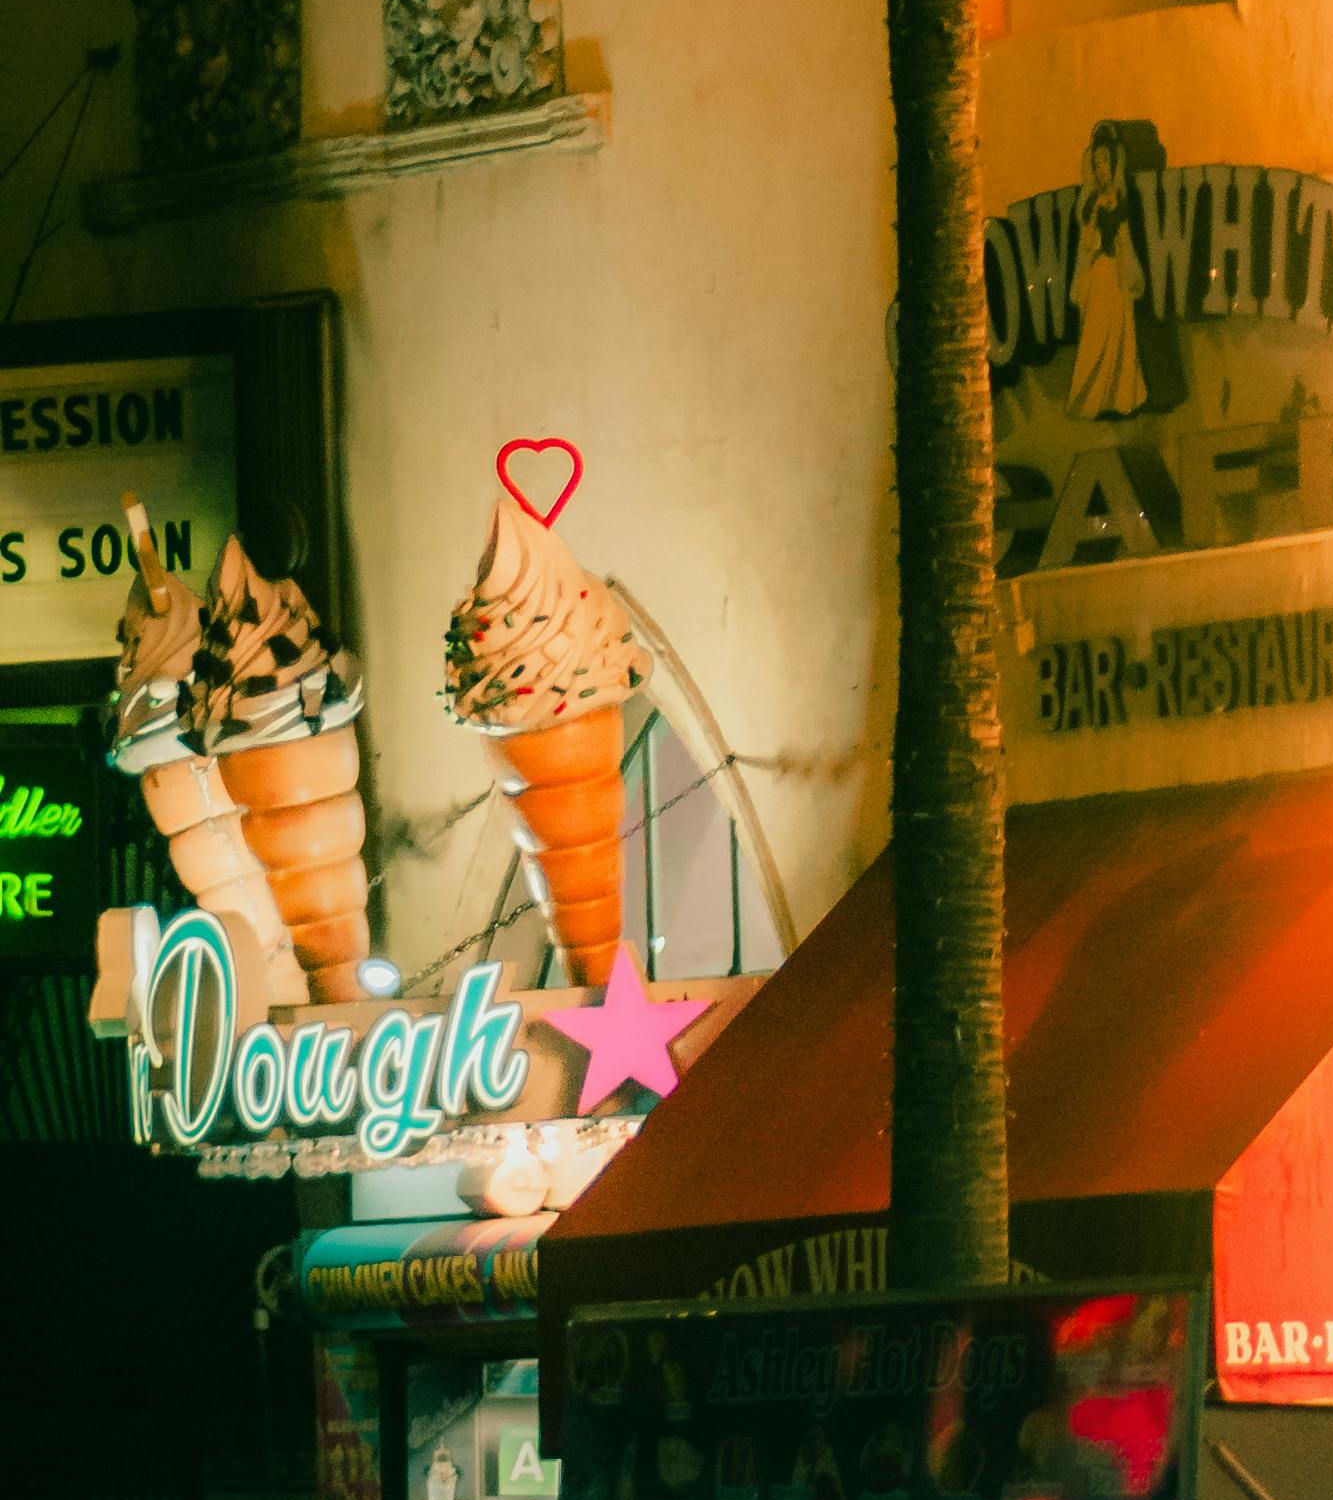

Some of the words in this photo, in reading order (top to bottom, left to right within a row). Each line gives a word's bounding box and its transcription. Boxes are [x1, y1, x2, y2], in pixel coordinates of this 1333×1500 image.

[0, 388, 184, 451] ESSION
[58, 522, 192, 579] SOON
[145, 908, 531, 1161] Dough
[510, 1440, 545, 1483] A
